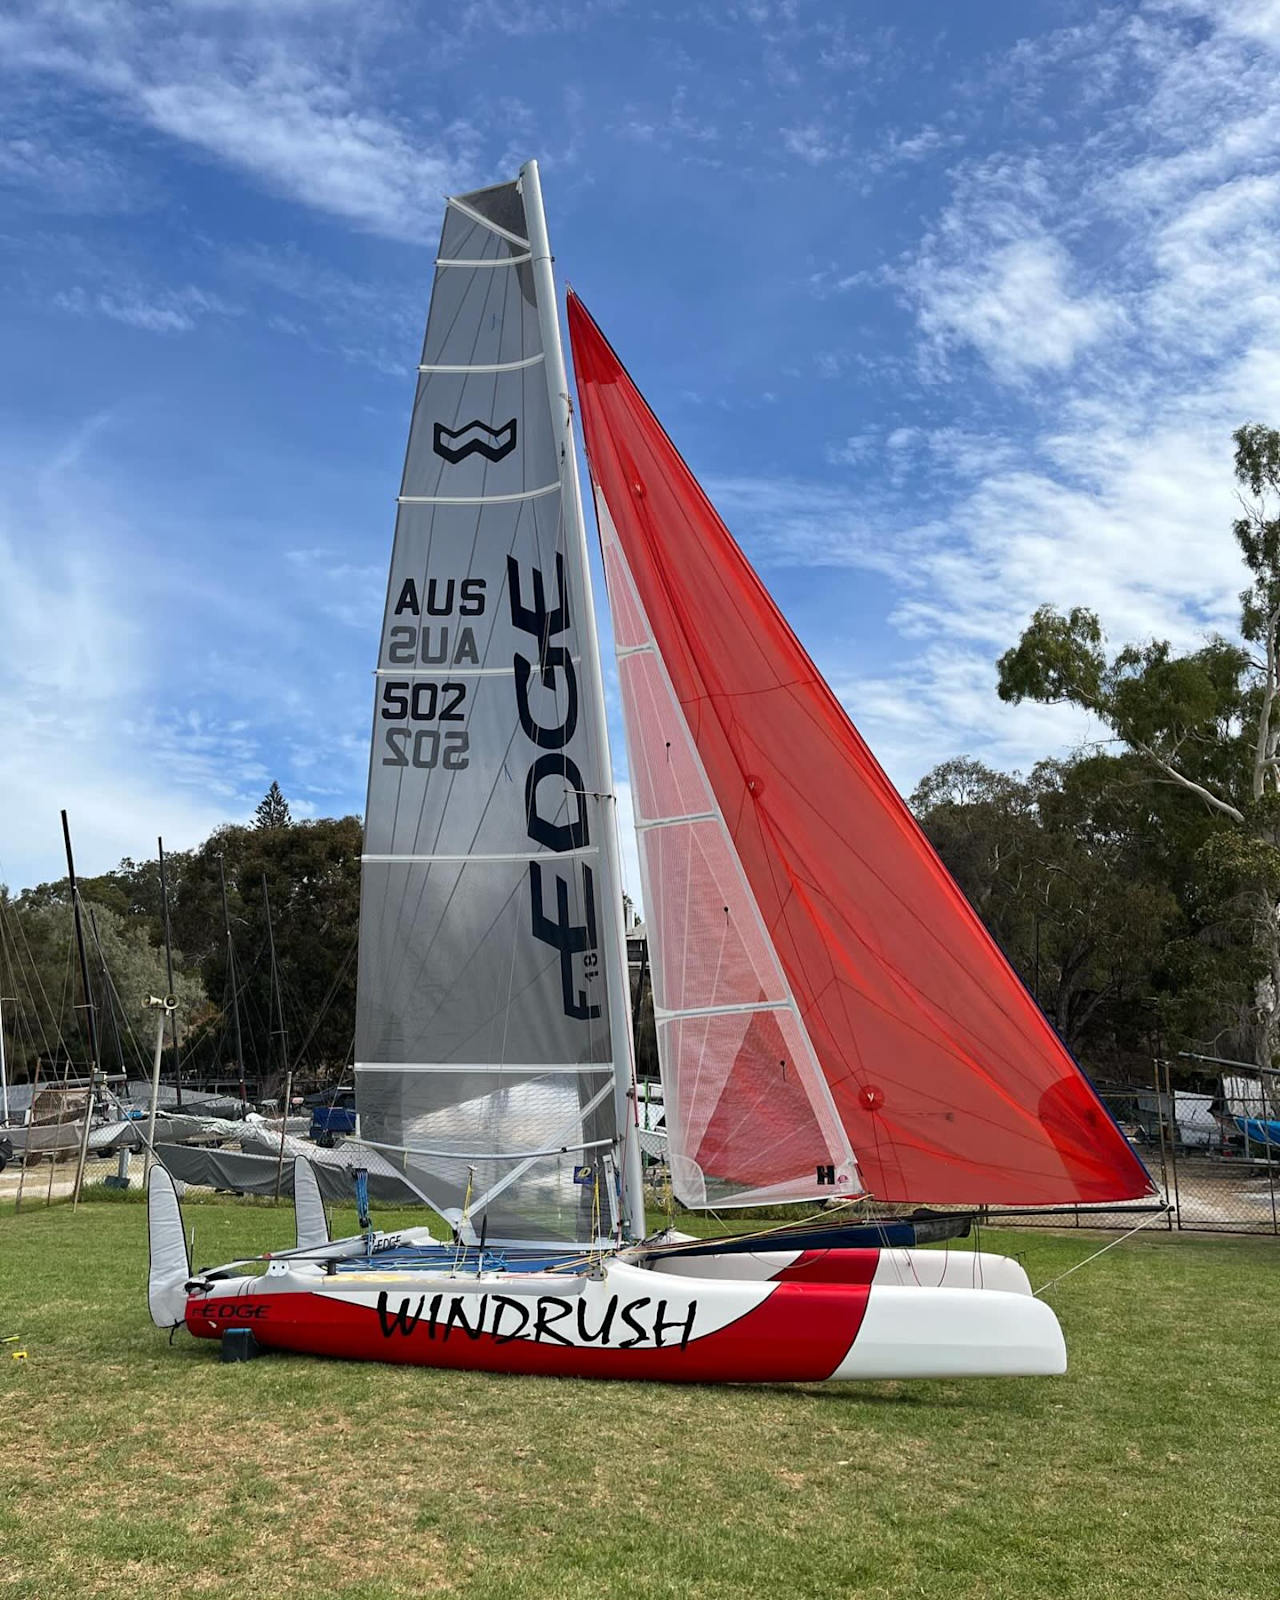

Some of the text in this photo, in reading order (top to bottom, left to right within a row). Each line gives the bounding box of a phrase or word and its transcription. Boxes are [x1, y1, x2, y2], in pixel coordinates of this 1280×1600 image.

[394, 578, 486, 616] AUS
[381, 682, 466, 721] 502
[507, 551, 598, 953] EDGE
[377, 1291, 697, 1352] WINDRUSH
